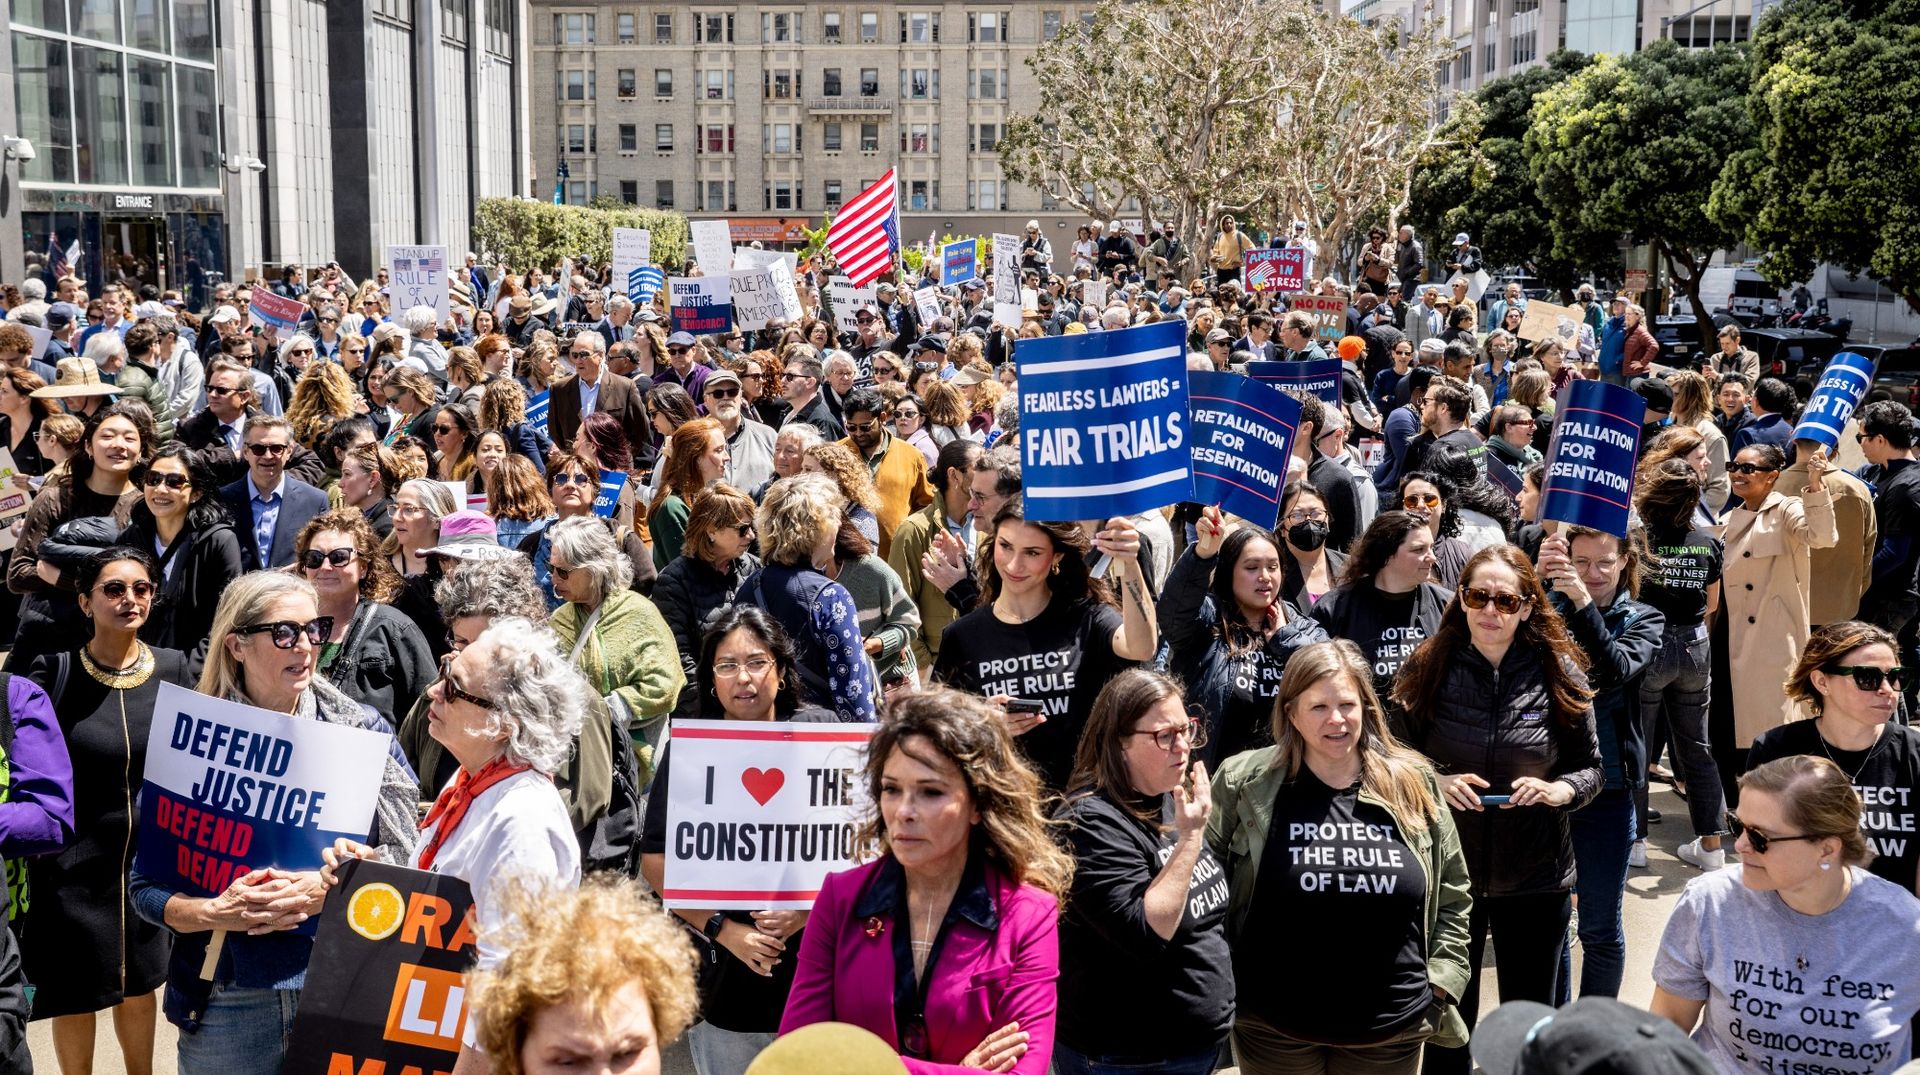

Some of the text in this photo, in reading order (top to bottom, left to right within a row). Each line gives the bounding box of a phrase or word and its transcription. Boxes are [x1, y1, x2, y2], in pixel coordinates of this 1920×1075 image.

[116, 195, 152, 208] ENTRANCE
[394, 248, 440, 260] STAND UP
[1249, 250, 1301, 264] AMERICA
[395, 270, 438, 286] RULE
[1280, 265, 1294, 276] IN
[408, 288, 422, 297] OF
[674, 284, 700, 294] DEFEND
[731, 276, 756, 294] DUE
[399, 294, 439, 310] LAW
[680, 295, 712, 306] JUSTICE
[1295, 299, 1344, 312] NO ONE
[674, 308, 698, 318] DEFEND
[680, 317, 726, 330] DEMOCRACY
[1320, 327, 1345, 339] LAW
[1024, 376, 1180, 413] FEARLESS LAWYERS =
[1274, 380, 1335, 392] RETALIATION
[1026, 411, 1183, 466] FAIR TRIALS
[1195, 409, 1284, 450] RETALIATION
[1558, 422, 1634, 452] ETALIATION
[1212, 430, 1245, 452] FOR
[1560, 442, 1596, 460] FOR
[1549, 462, 1628, 493] ESENTATION
[0, 495, 24, 510] ECTION
[1658, 546, 1711, 555] STAND WITH
[1684, 570, 1708, 578] NEST
[1378, 644, 1398, 658] HE
[979, 650, 1071, 678] PROTECT
[1240, 662, 1284, 680] HE RU
[1376, 662, 1398, 676] OF
[982, 672, 1075, 698] THE RULE
[1236, 676, 1280, 697] OF LA
[1041, 696, 1070, 716] AW
[170, 711, 294, 778] DEFEND
[705, 766, 854, 807] I THE
[191, 766, 326, 831] JUSTICE
[156, 795, 254, 858] DEFEND
[1290, 822, 1392, 843] PROTECT
[1288, 846, 1404, 868] THE RULE
[1866, 838, 1906, 857] AW
[1300, 872, 1397, 894] OF LAW
[1190, 894, 1206, 918] OF
[1204, 878, 1229, 911] LAW
[1734, 960, 1894, 1001] With fear
[400, 978, 465, 1039] LI
[1730, 992, 1860, 1030] for our
[1730, 1018, 1893, 1064] democracy,
